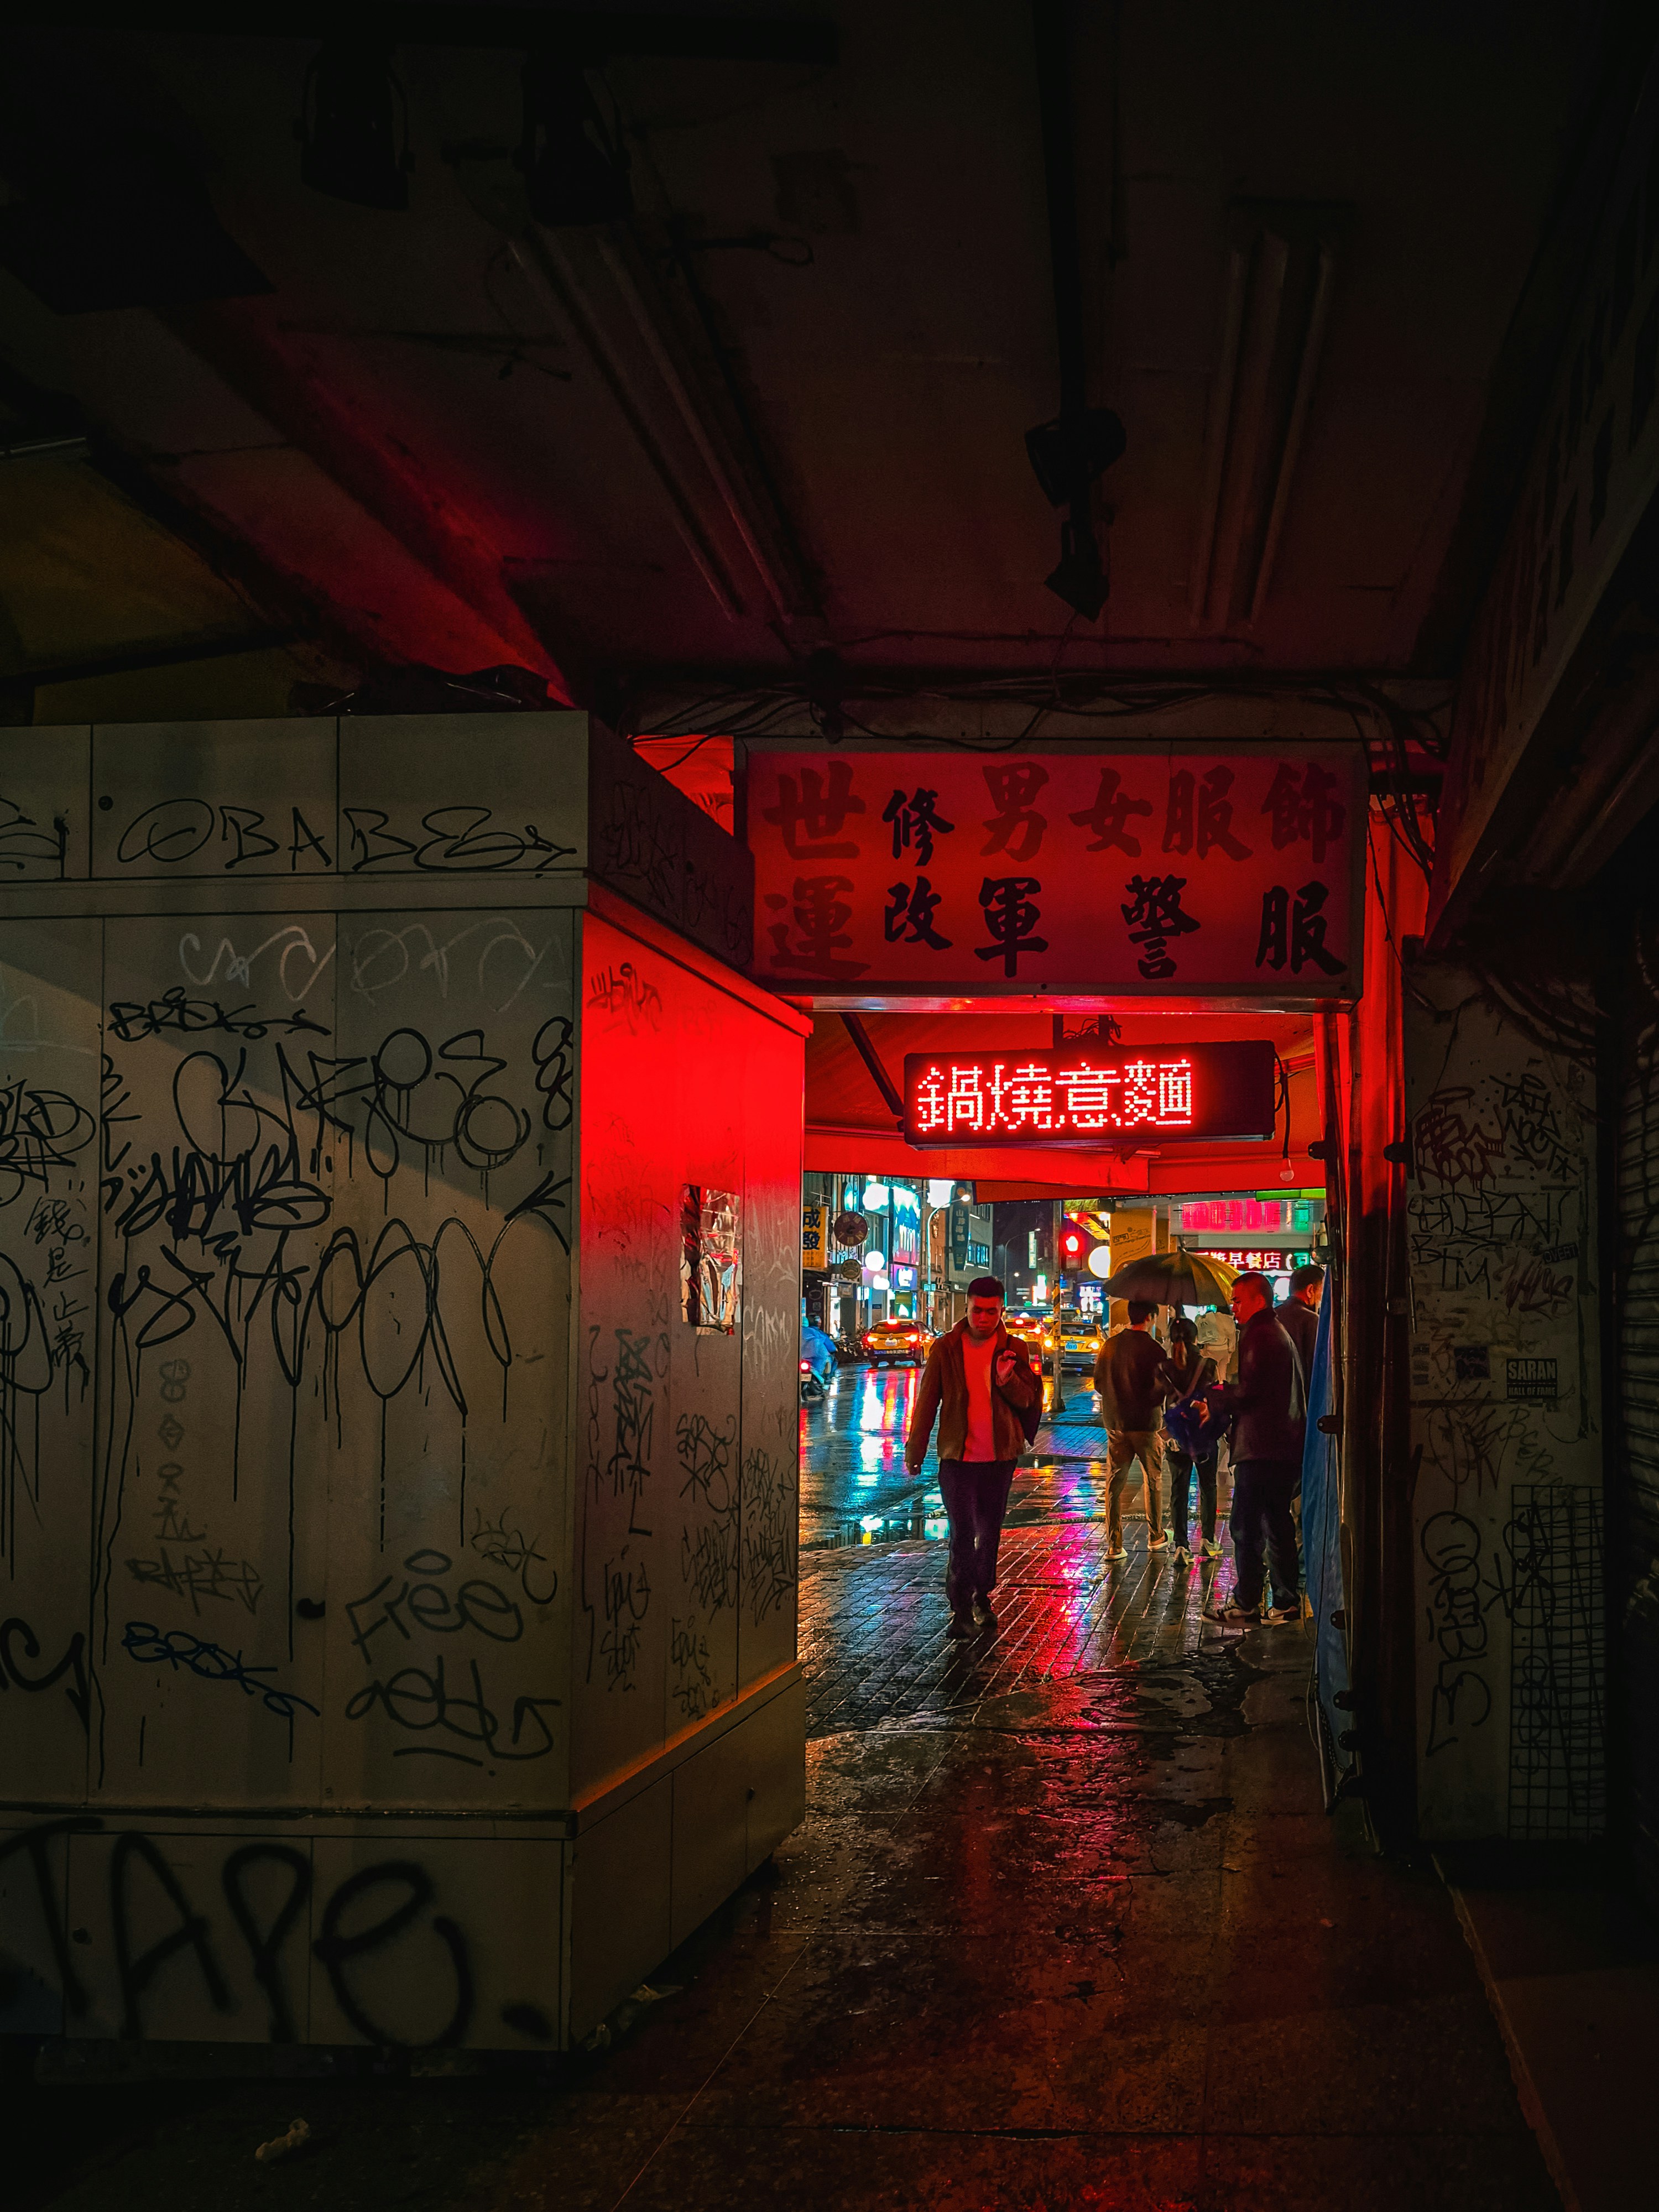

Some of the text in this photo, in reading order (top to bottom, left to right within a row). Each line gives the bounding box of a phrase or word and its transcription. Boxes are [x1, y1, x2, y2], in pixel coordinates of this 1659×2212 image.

[918, 1058, 1191, 1131] 鍋燒意麵
[1507, 1360, 1556, 1381] SARAN
[1509, 1386, 1556, 1396] HALL OF FAME
